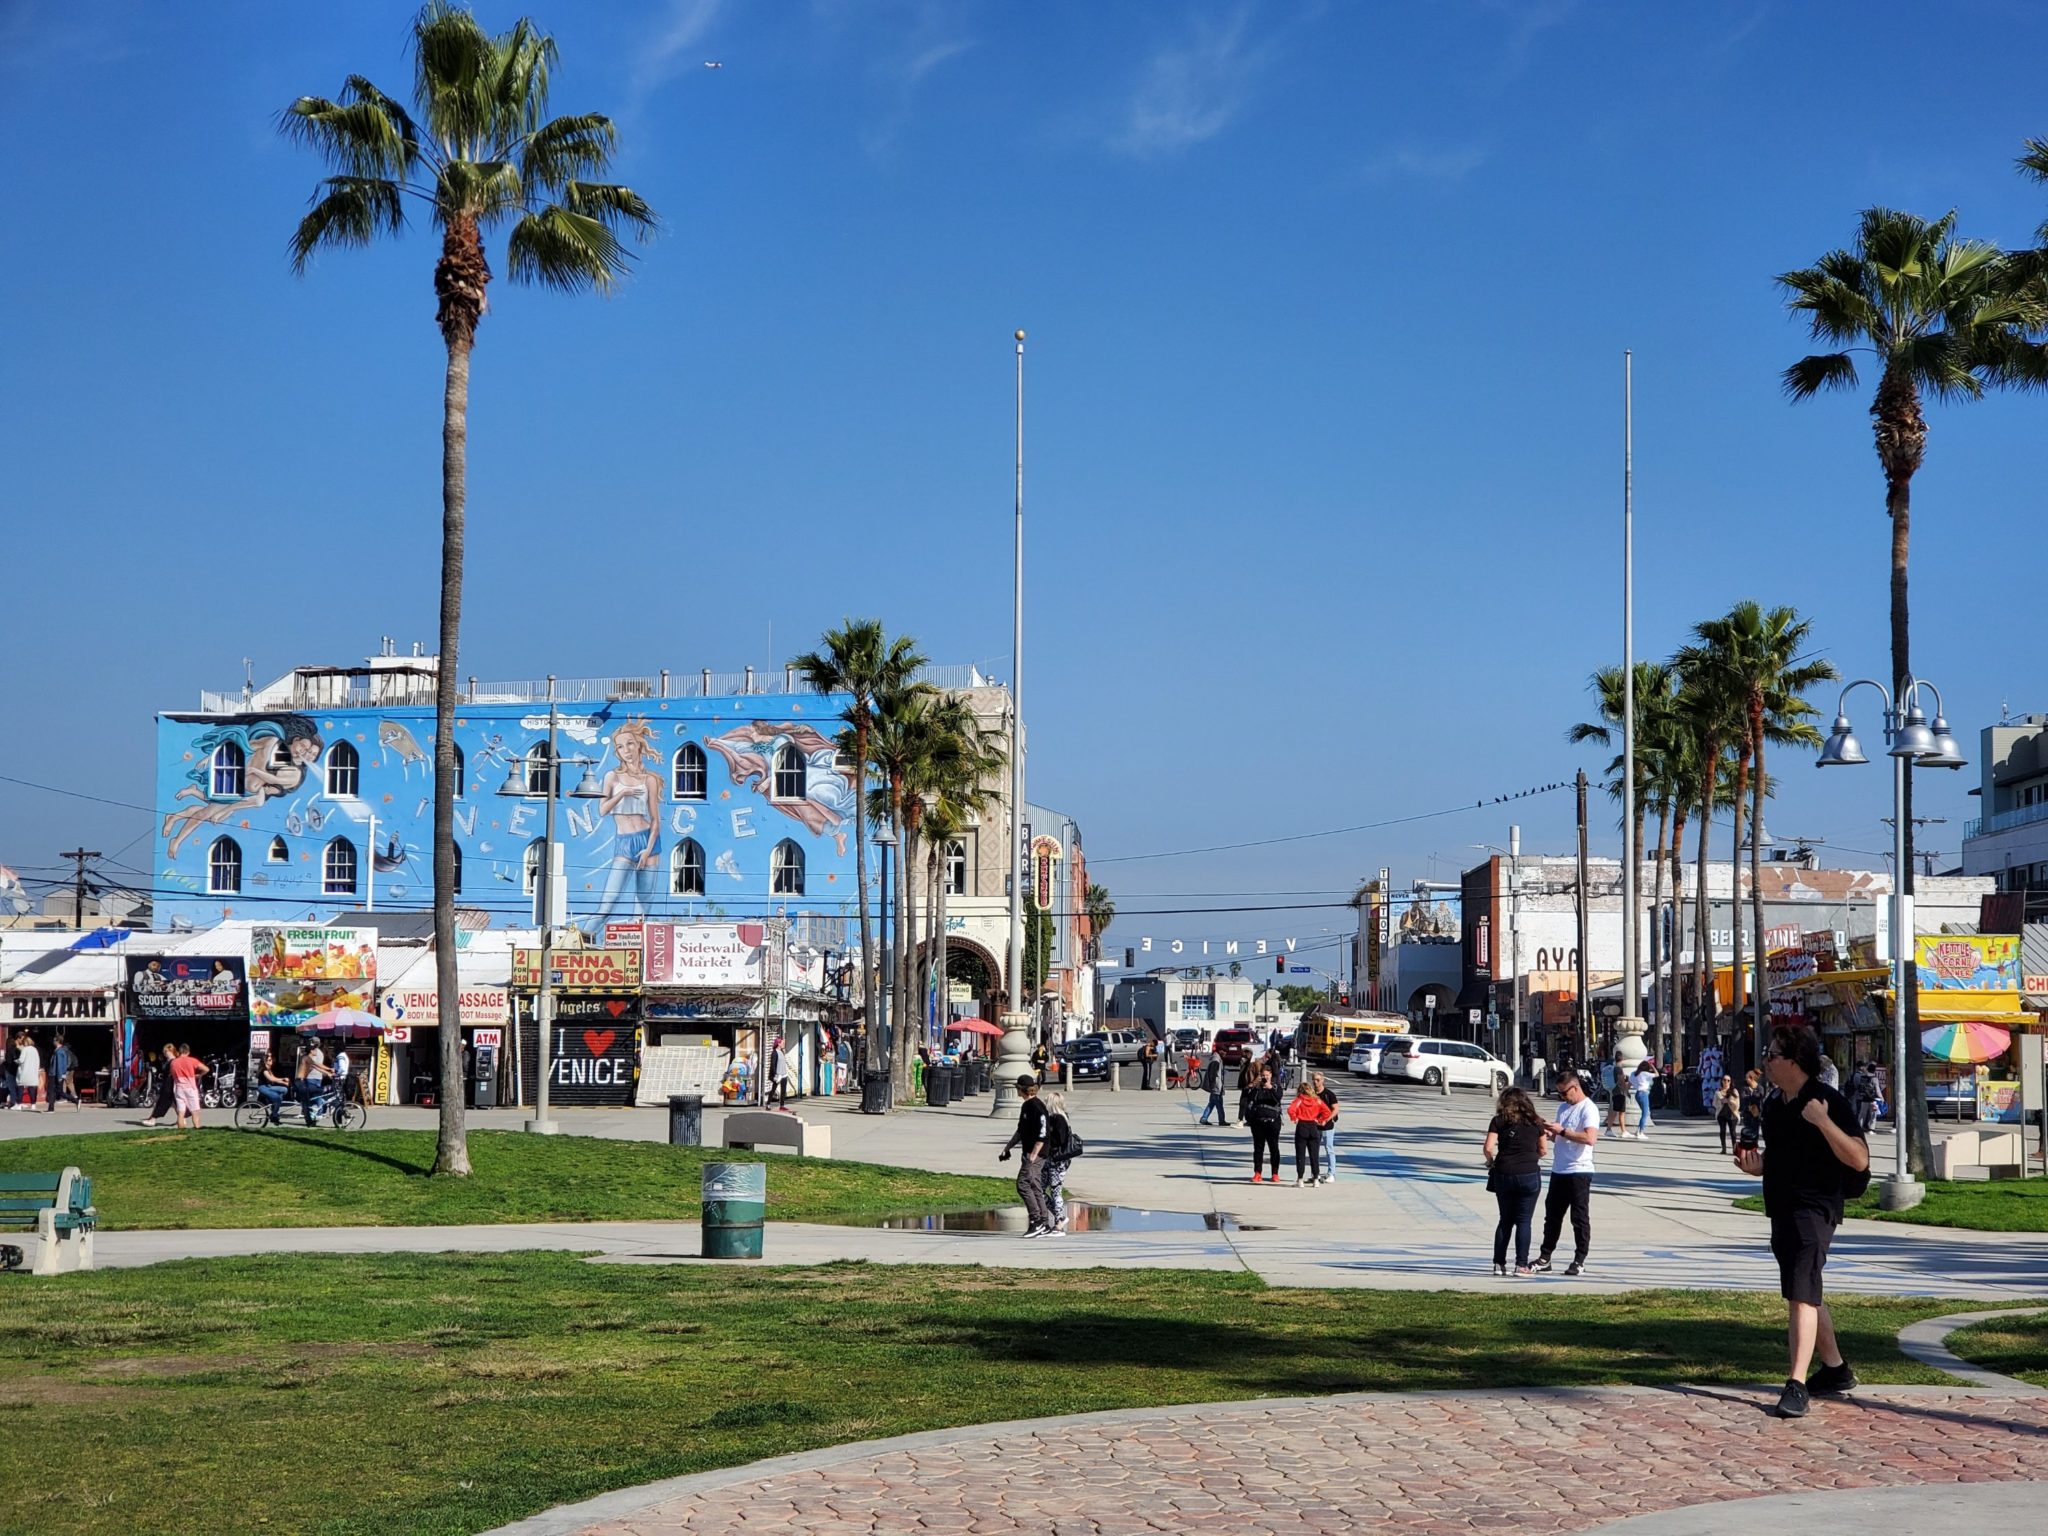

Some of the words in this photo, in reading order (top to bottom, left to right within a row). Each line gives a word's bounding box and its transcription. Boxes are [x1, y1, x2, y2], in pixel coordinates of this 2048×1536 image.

[1021, 827, 1029, 872] BAR
[325, 929, 357, 940] FRUIT
[653, 926, 666, 982] VENICE
[679, 942, 746, 954] Sidewalk
[1939, 943, 1970, 957] KETTLE
[516, 950, 526, 965] 2
[628, 951, 637, 966] 2
[679, 956, 733, 968] Market
[513, 974, 527, 983] $10
[529, 968, 624, 984] TTOOS
[626, 975, 638, 984] $10
[138, 994, 196, 1006] SCOOT-E-BIKE
[196, 994, 234, 1007] RENTALS
[403, 993, 437, 1008] VENIC
[459, 992, 504, 1007] ASSAGE
[12, 997, 107, 1019] BAZAAR
[407, 1011, 424, 1020] BODY
[459, 1010, 474, 1019] OOT
[475, 1010, 502, 1021] Massage
[253, 1034, 269, 1043] ATM
[476, 1033, 498, 1045] ATM
[557, 1028, 566, 1056] I
[377, 1049, 389, 1102] SSAGE
